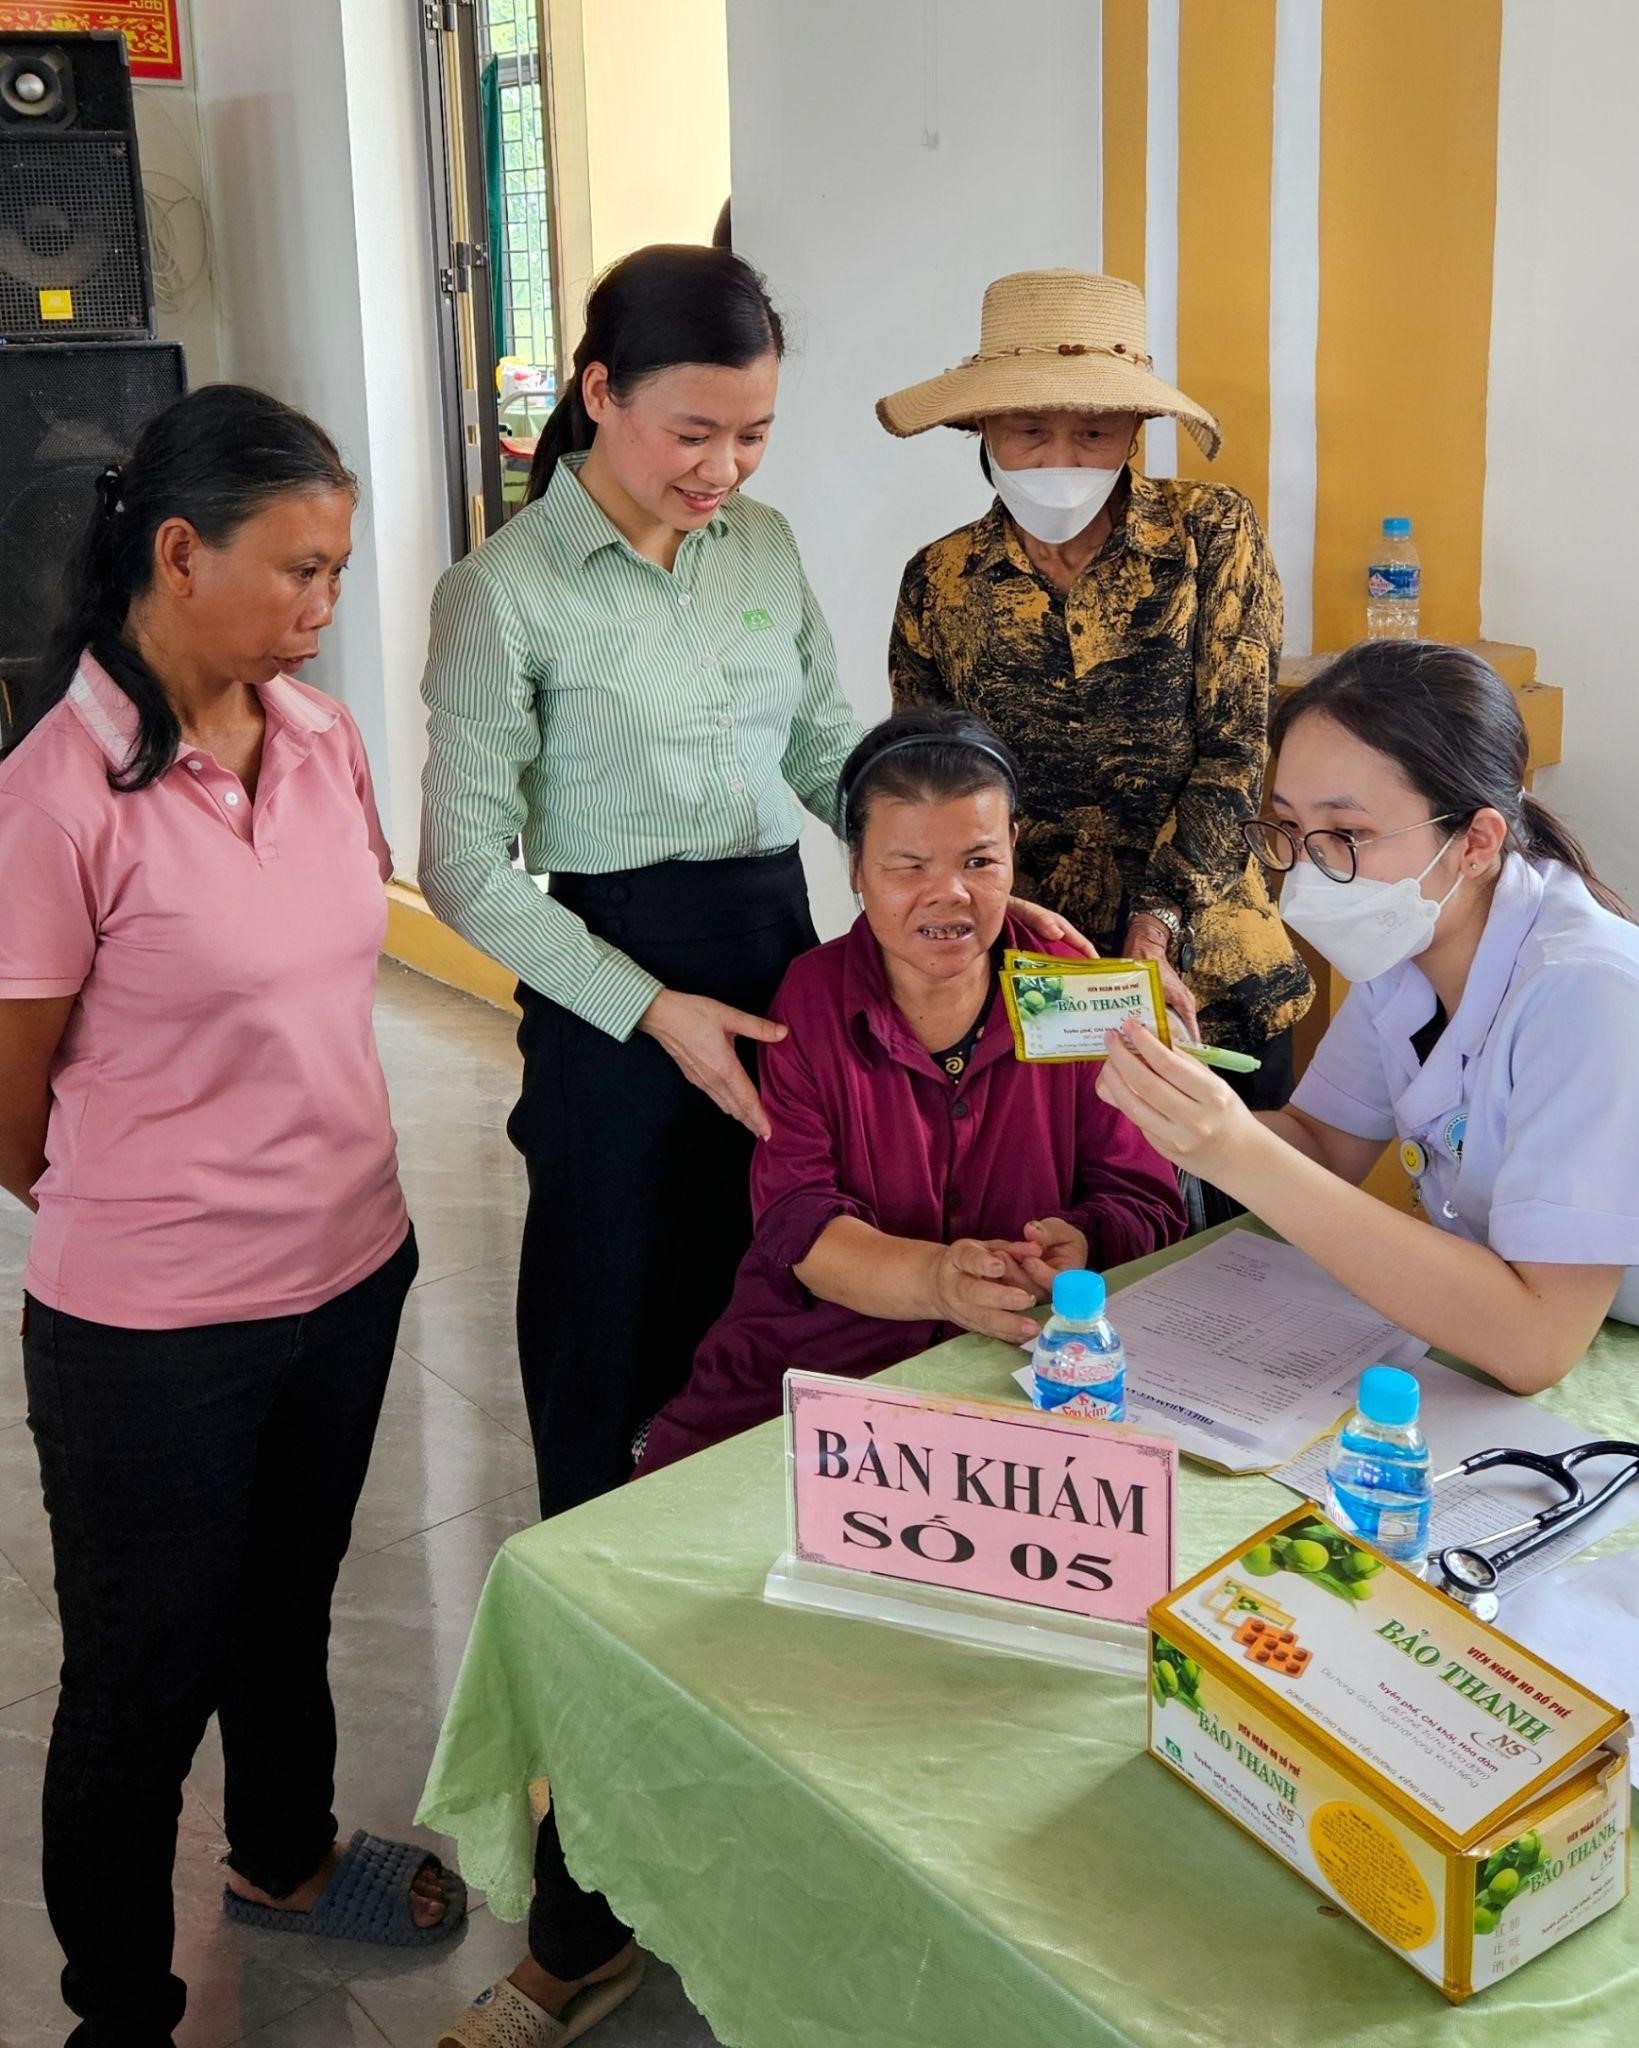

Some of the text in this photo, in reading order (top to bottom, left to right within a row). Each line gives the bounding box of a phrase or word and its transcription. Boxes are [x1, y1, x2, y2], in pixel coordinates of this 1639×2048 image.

[1090, 994, 1141, 1011] THANH
[813, 1421, 1150, 1537] BÀN KHÁM
[842, 1511, 1114, 1592] SỐ 05
[1375, 1617, 1552, 1747] BẢO THANH
[1465, 1647, 1491, 1664] VIÊN
[1516, 1681, 1535, 1694] HO
[1547, 1701, 1572, 1718] PHẾ
[1198, 1712, 1231, 1751] BẢO
[1236, 1740, 1297, 1803] THANH
[1491, 1732, 1525, 1757] NS
